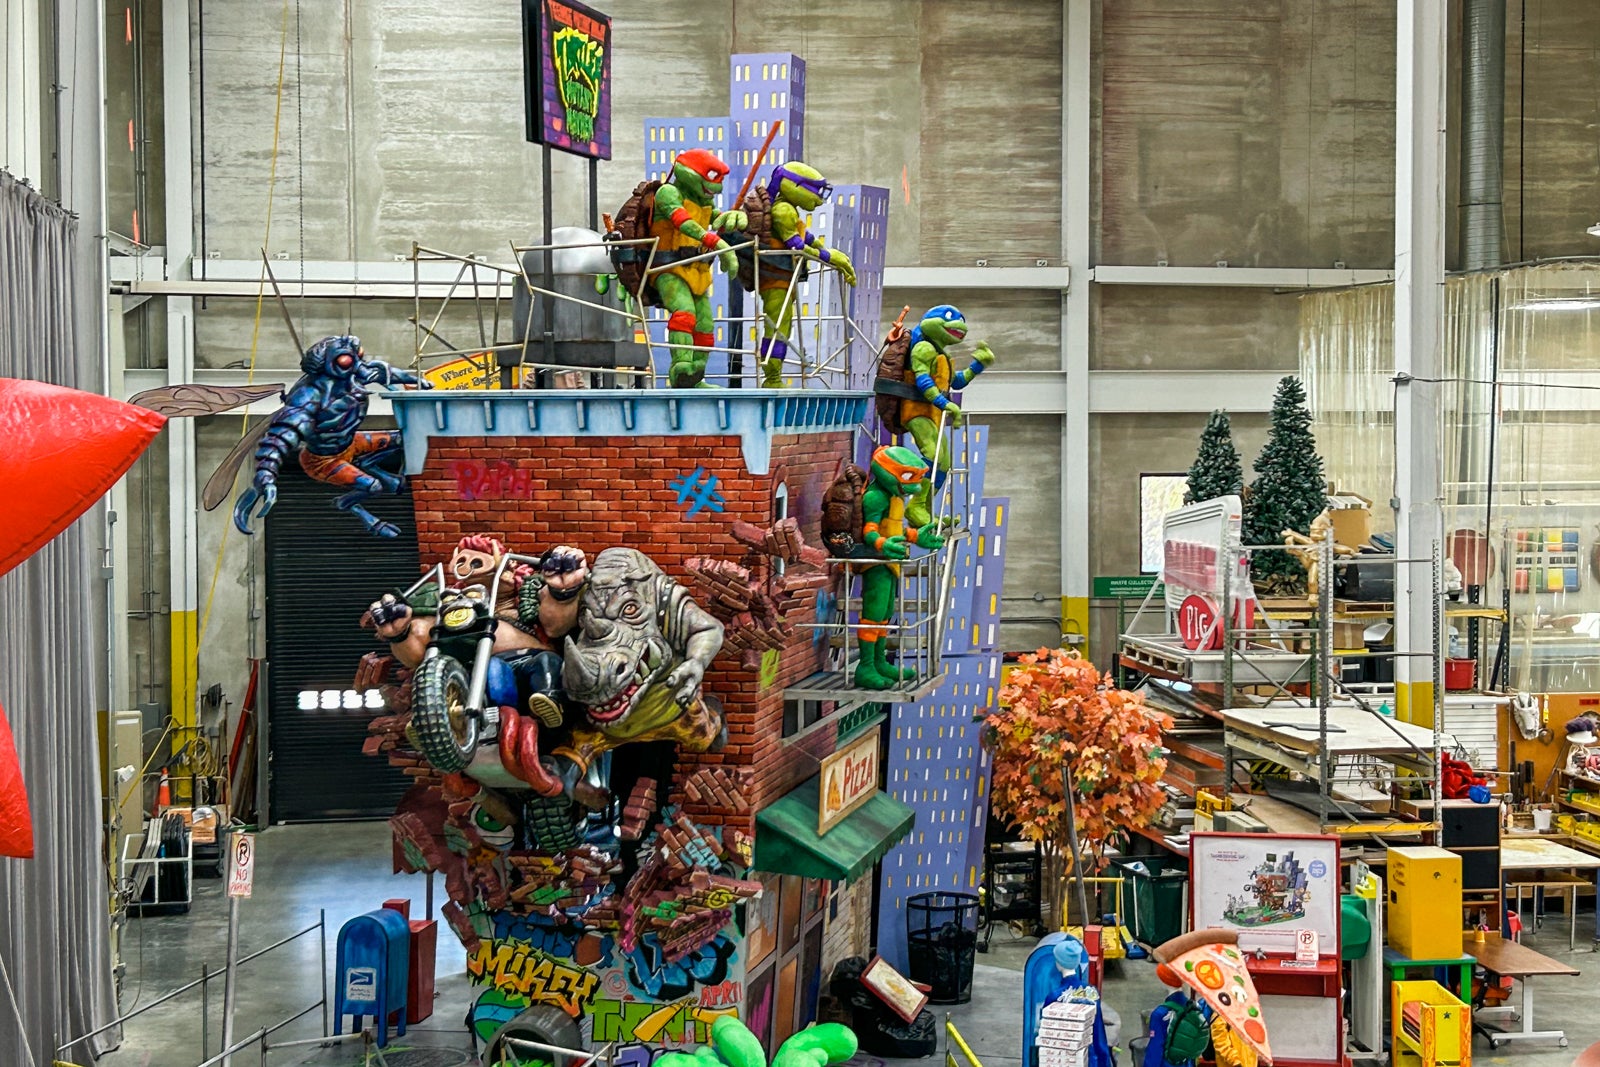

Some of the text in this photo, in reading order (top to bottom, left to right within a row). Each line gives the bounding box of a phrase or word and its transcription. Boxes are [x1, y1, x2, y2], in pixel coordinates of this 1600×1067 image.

[440, 366, 473, 382] Where
[456, 460, 533, 500] RAPH
[1186, 605, 1208, 644] PIG
[235, 869, 247, 880] NO
